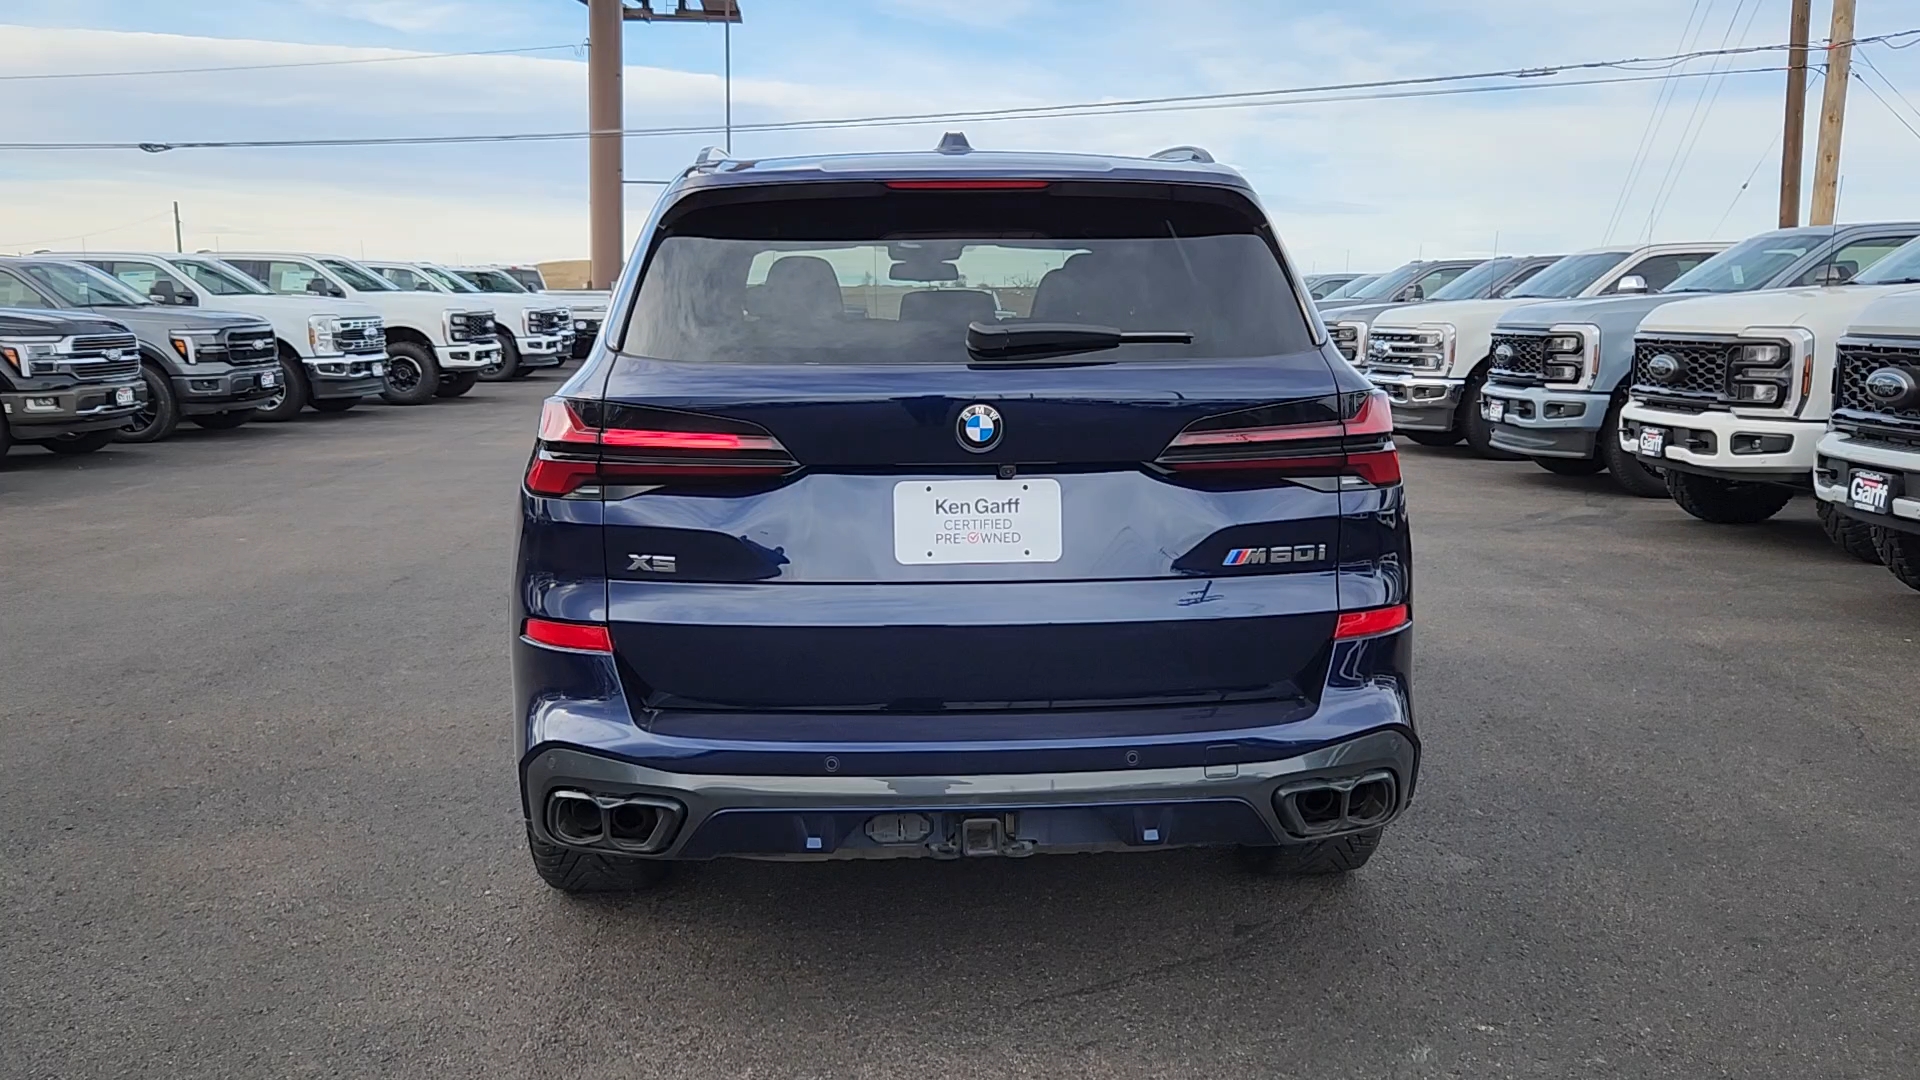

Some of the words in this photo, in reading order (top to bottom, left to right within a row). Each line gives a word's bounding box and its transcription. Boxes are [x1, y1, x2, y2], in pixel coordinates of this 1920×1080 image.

[961, 406, 1000, 421] BMW
[1850, 477, 1889, 508] Garff
[935, 499, 971, 515] Ken
[974, 498, 1020, 514] Garff
[943, 518, 1013, 531] CERTIFIED
[626, 554, 677, 573] X5
